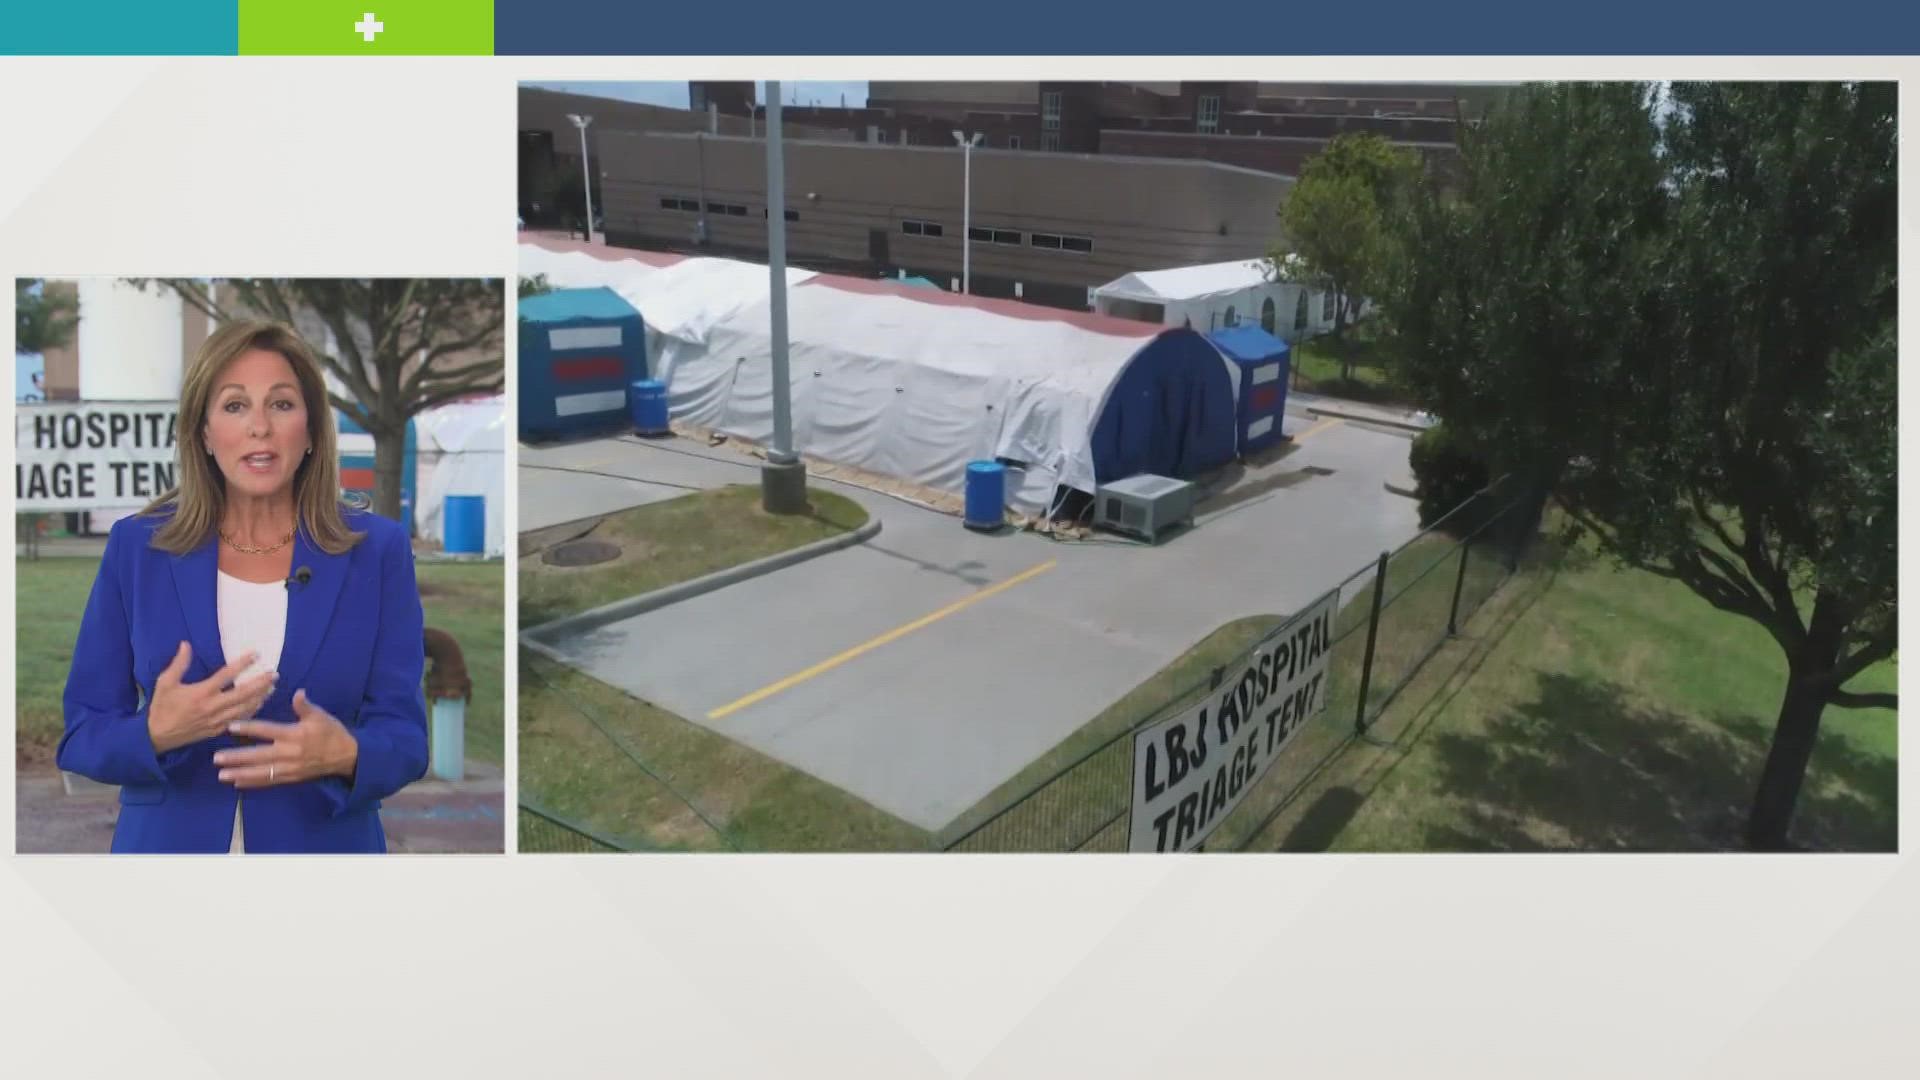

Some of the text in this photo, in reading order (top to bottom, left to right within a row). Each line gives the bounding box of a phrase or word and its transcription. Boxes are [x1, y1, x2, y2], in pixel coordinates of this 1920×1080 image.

[1145, 609, 1330, 803] LBJ HOSPITAL
[1153, 671, 1323, 853] TRIAGE TENT
